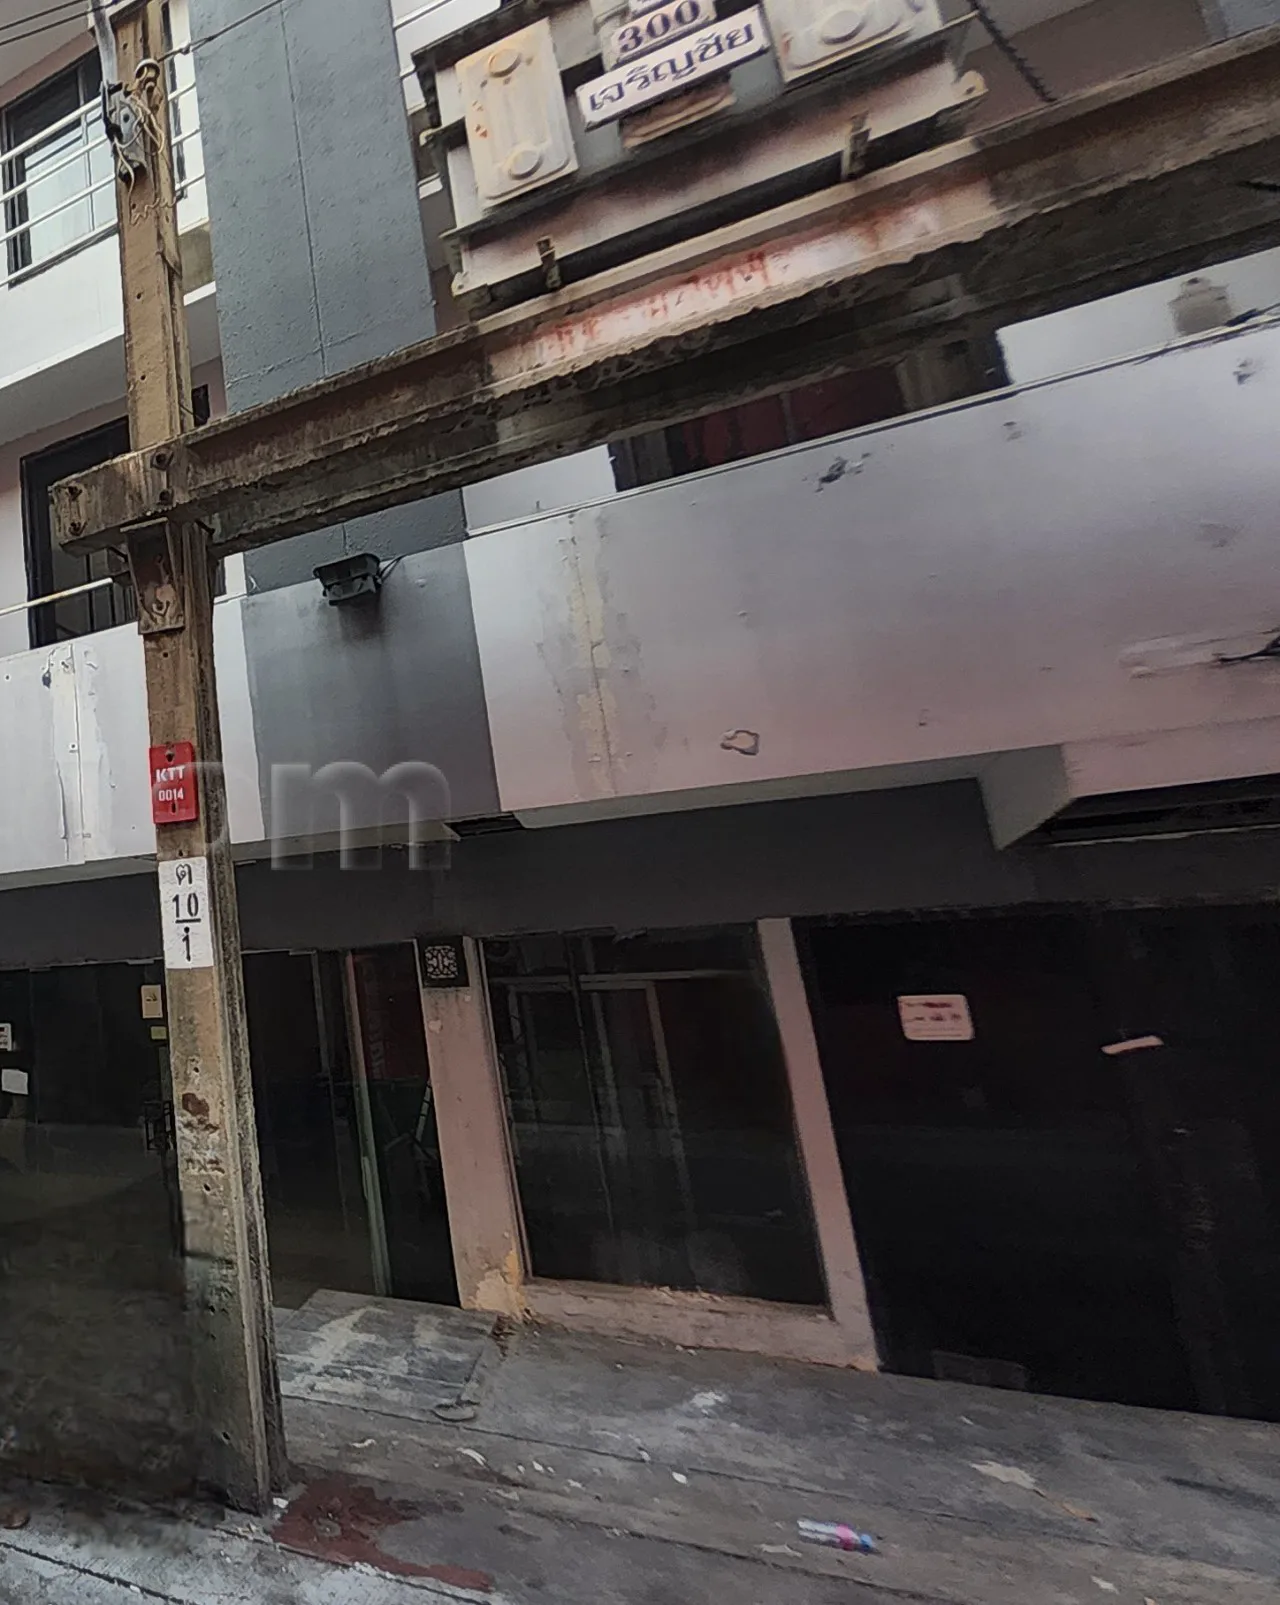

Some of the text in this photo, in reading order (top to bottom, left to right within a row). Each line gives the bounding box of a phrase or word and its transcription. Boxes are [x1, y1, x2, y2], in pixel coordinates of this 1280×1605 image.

[617, 0, 701, 54] 300
[155, 765, 186, 783] KTT
[158, 787, 184, 802] 0014
[172, 892, 199, 918] 10
